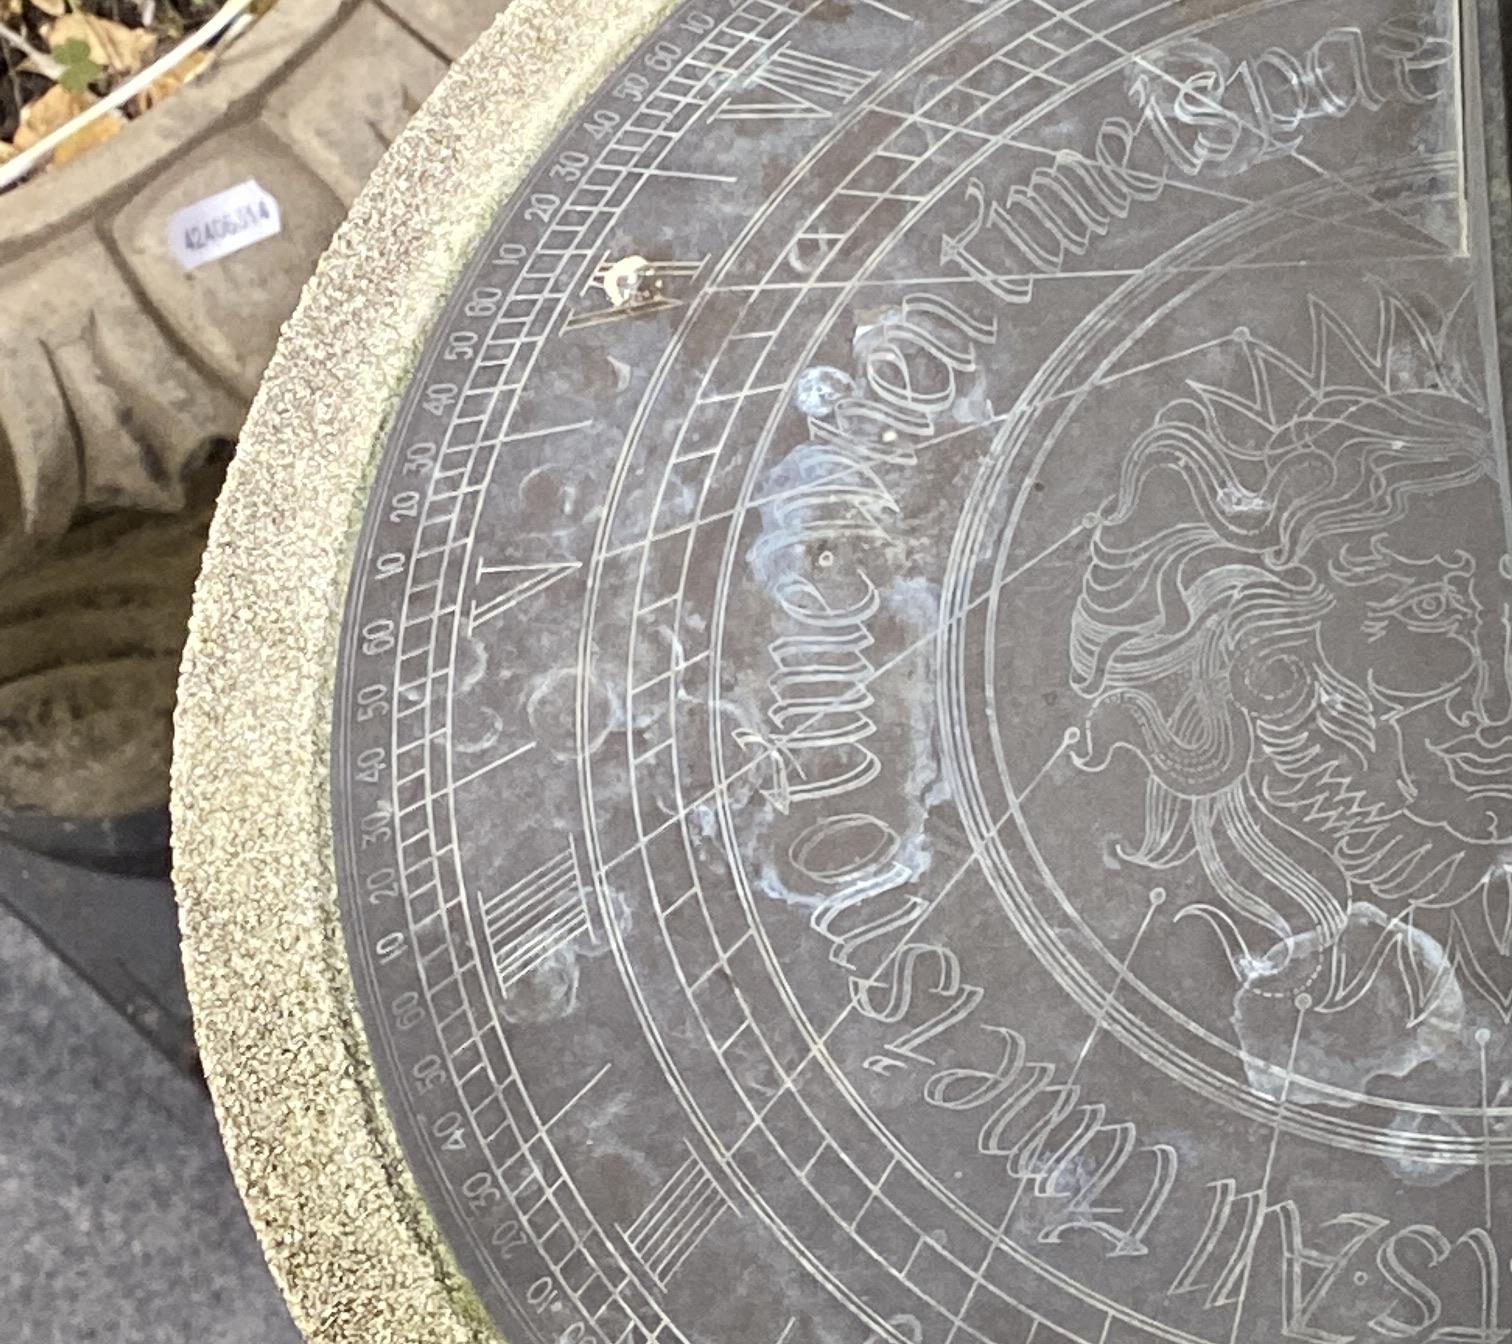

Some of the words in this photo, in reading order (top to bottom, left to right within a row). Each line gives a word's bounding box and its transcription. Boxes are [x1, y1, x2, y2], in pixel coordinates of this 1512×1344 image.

[680, 12, 715, 35] 10
[493, 245, 527, 265] 10
[521, 193, 560, 220] 20
[549, 151, 590, 180] 30
[582, 110, 621, 136] 40
[613, 75, 650, 100] 50
[644, 43, 683, 70] 60
[938, 113, 1168, 305] time
[464, 288, 503, 315] 60
[443, 333, 480, 358] 50
[422, 385, 459, 411] 40
[401, 445, 437, 474] 30
[388, 493, 421, 519] 20
[375, 554, 406, 577] 10
[469, 556, 582, 636] V
[361, 621, 396, 653] 60
[356, 685, 390, 718] 50
[355, 748, 387, 781] 40
[360, 811, 390, 846] 30
[366, 868, 397, 903] 20
[785, 814, 929, 971] no
[376, 931, 407, 963] 10
[392, 990, 424, 1029] 60
[845, 940, 984, 1076] is
[413, 1054, 445, 1090] 50
[433, 1111, 468, 1154] 40
[924, 1021, 1179, 1259] time
[463, 1171, 496, 1209] 30
[492, 1218, 525, 1257] 20
[526, 1275, 558, 1312] 10
